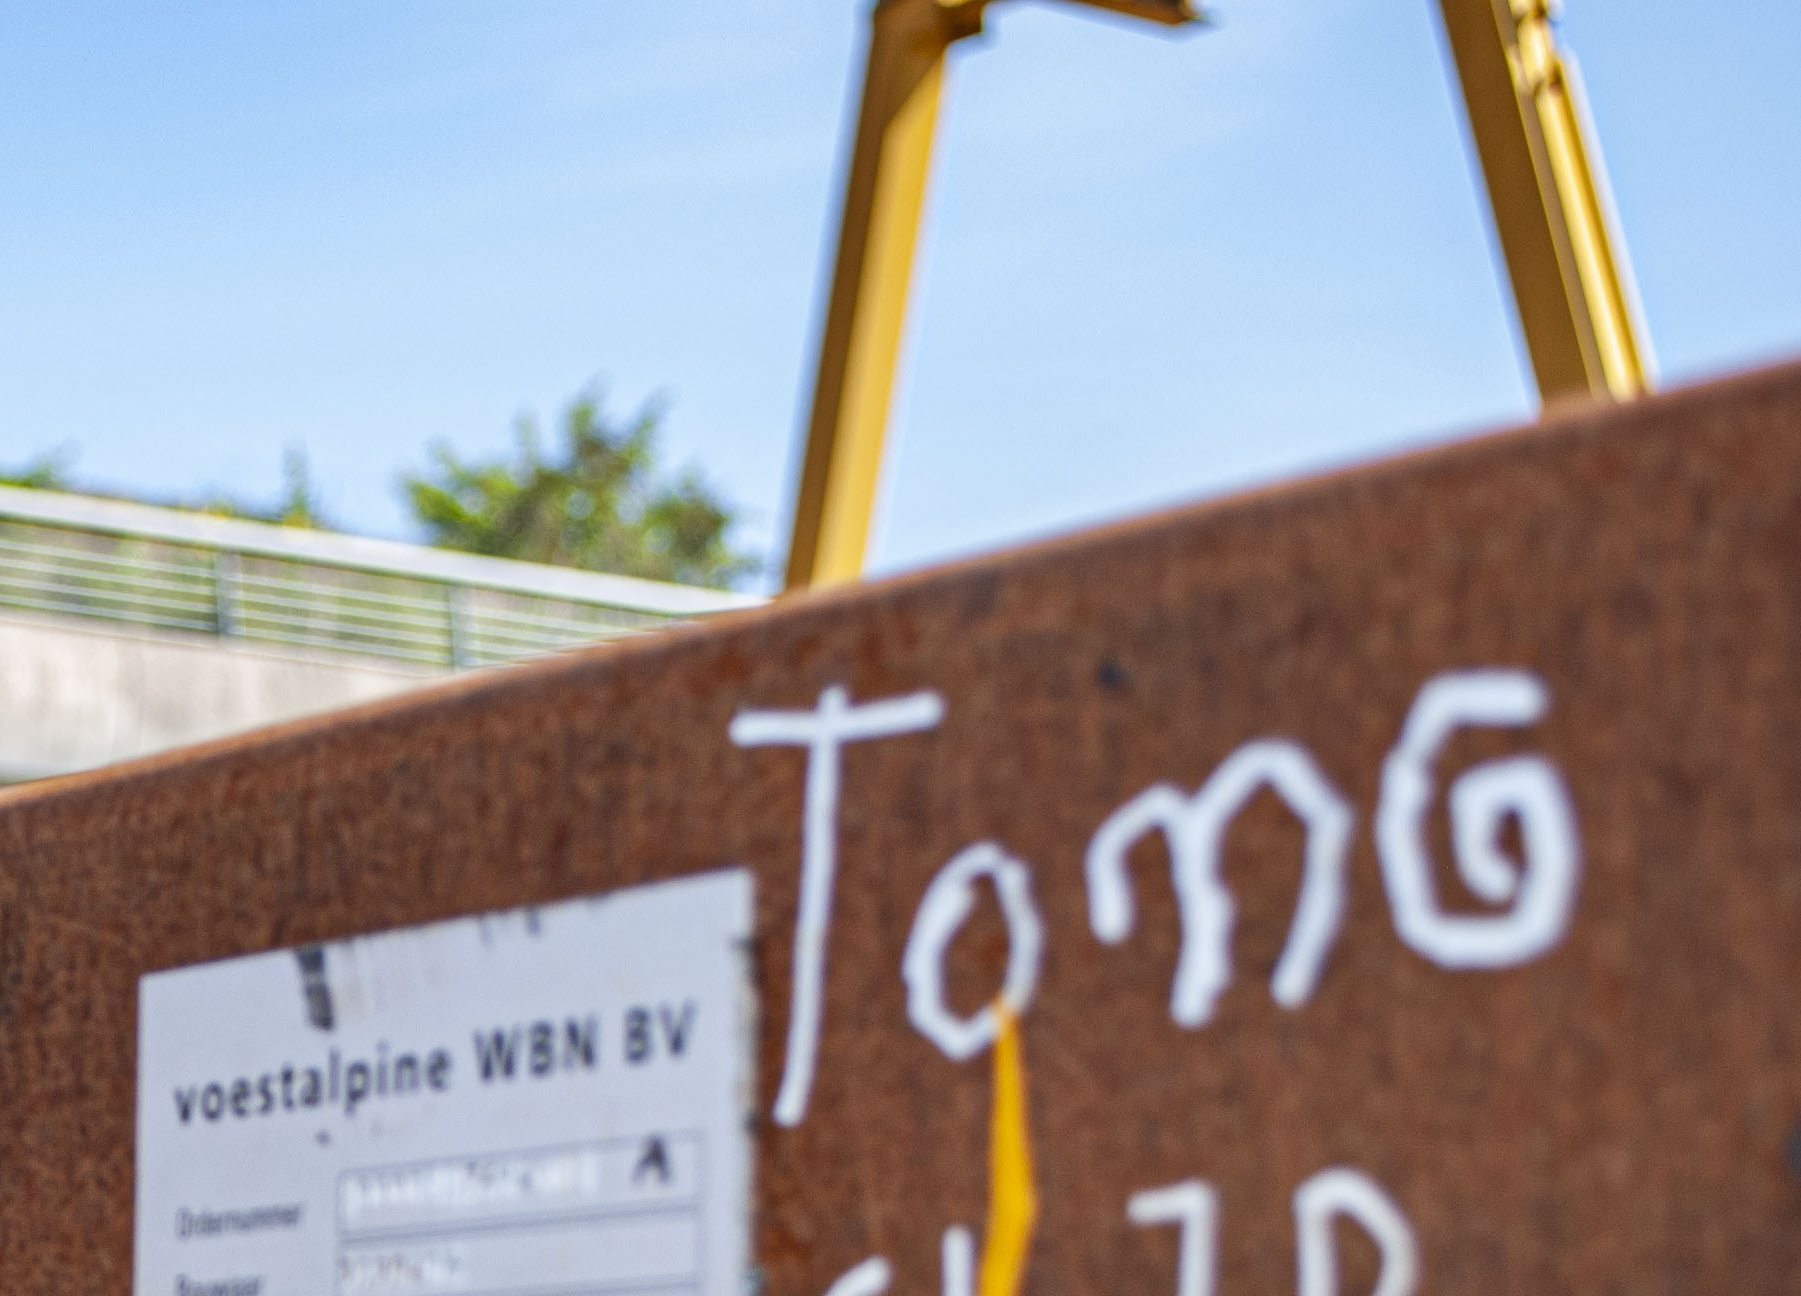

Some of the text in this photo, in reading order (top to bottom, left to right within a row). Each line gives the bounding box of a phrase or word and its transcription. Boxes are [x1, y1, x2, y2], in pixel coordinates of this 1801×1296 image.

[173, 1001, 696, 1120] voestalpine WBN BV
[632, 1134, 673, 1184] A
